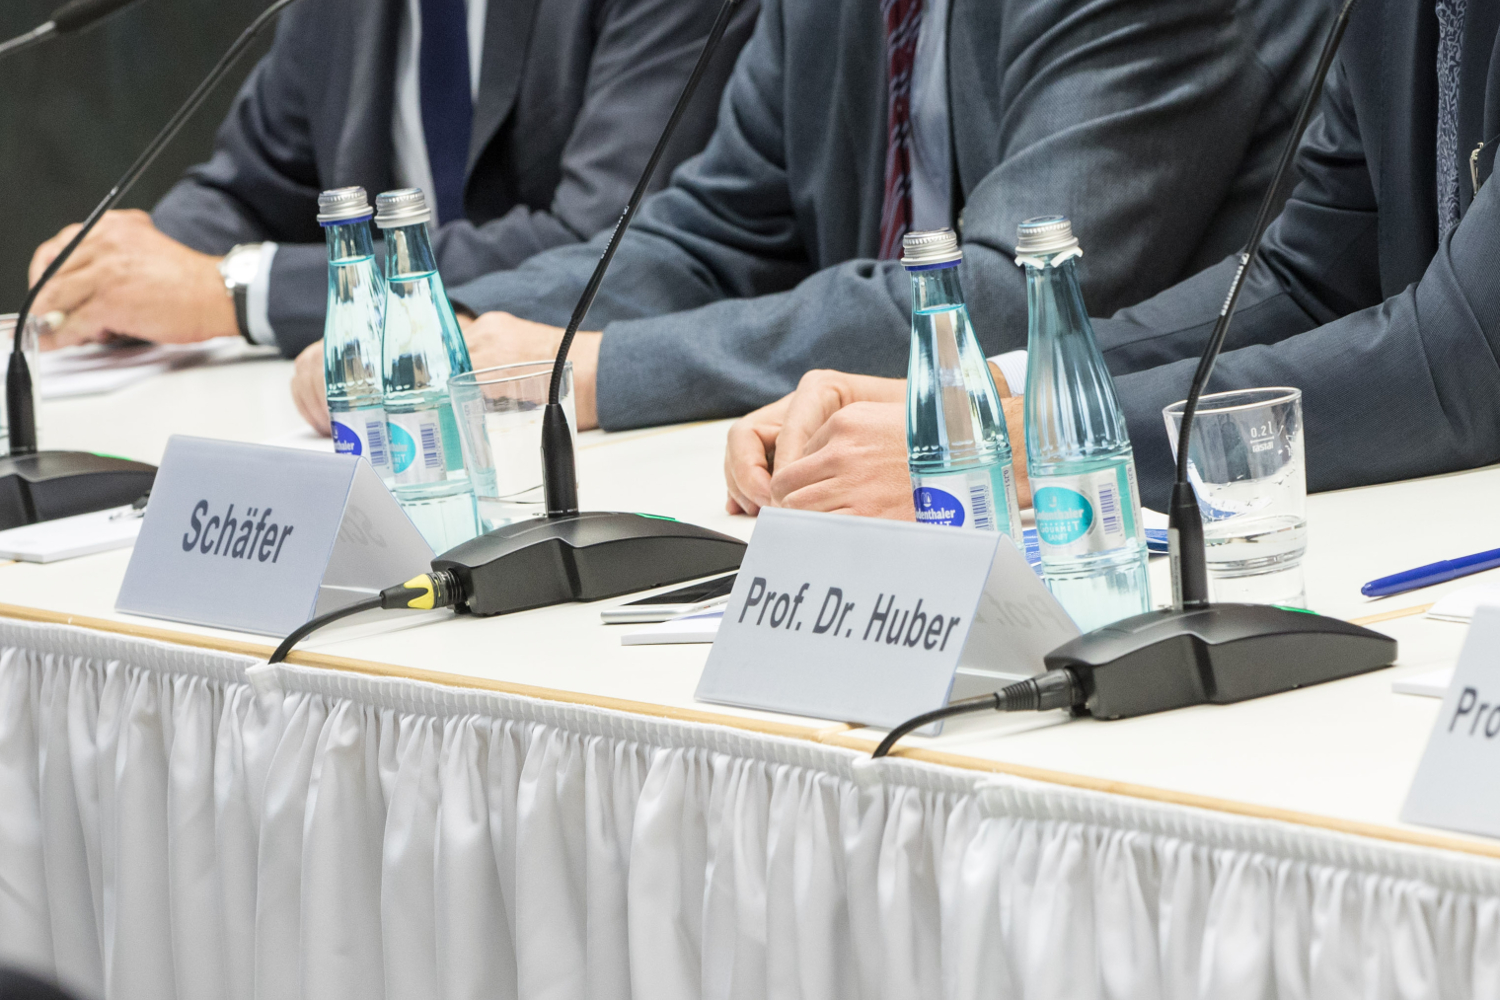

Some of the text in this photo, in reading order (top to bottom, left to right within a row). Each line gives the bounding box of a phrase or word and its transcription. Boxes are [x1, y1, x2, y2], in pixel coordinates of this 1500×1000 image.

[182, 499, 294, 564] Schäfer
[738, 576, 961, 652] Prof. Dr. Huber
